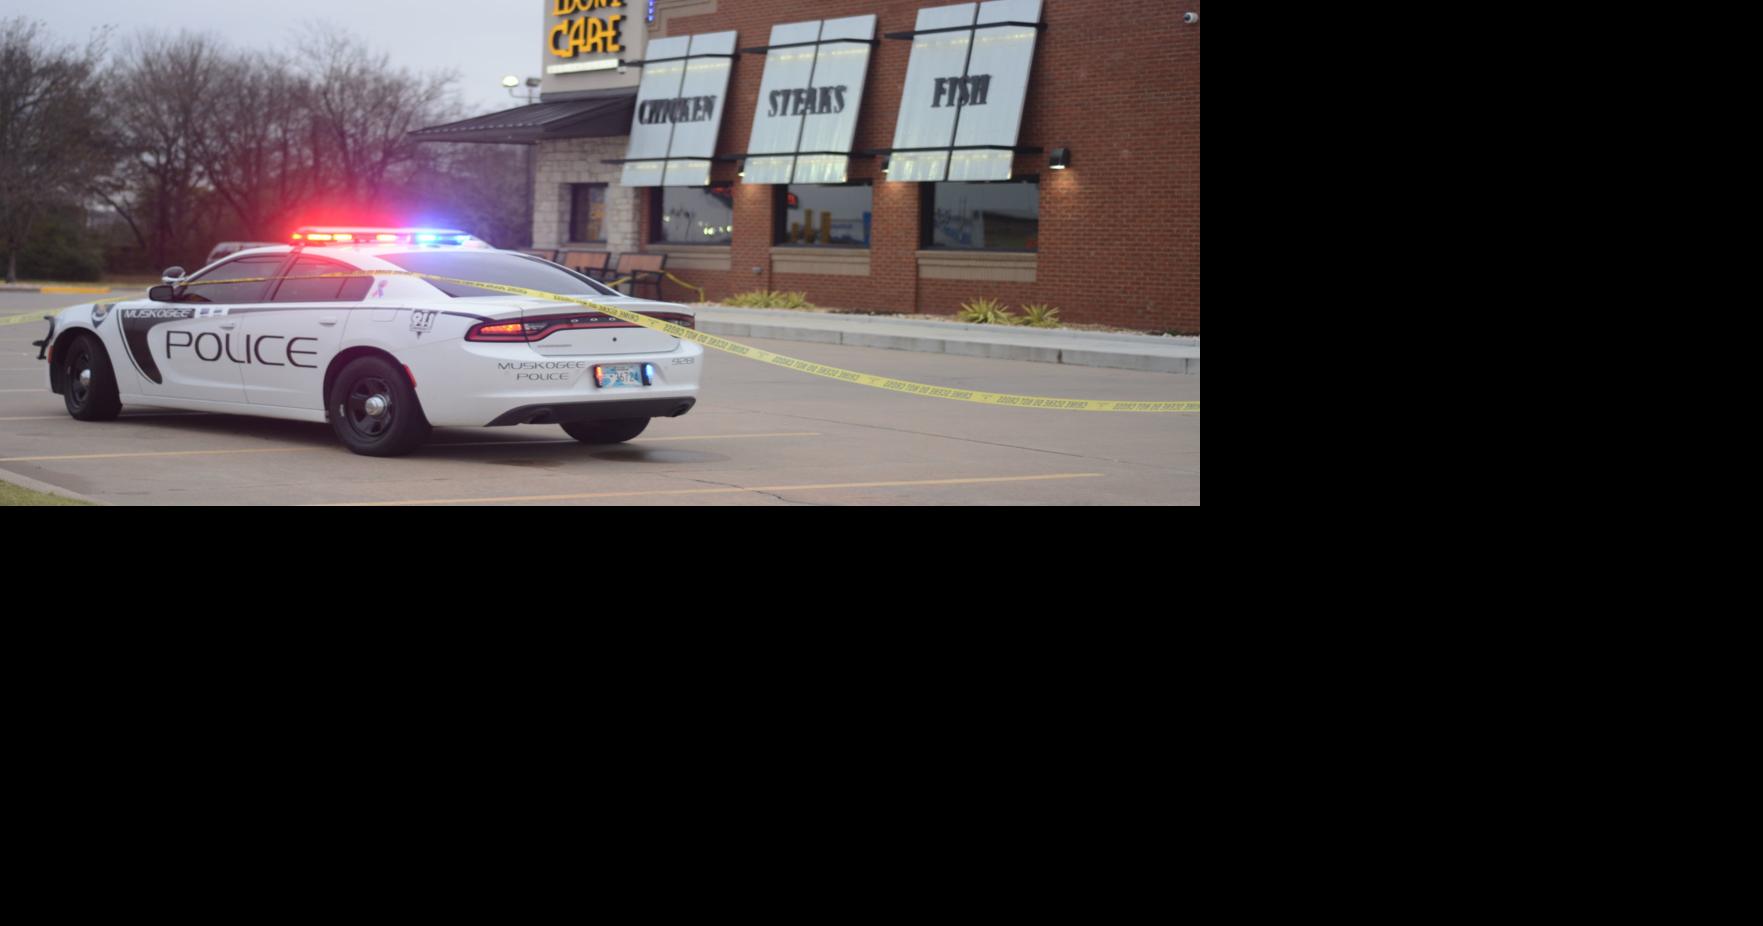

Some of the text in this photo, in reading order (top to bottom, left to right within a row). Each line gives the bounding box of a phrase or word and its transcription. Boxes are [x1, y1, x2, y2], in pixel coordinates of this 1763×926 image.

[548, 15, 622, 58] CARE
[768, 85, 847, 117] STEAKS
[931, 74, 992, 108] FISH
[638, 95, 717, 125] CHICKEN
[124, 309, 191, 319] MUSKOGEE
[166, 331, 318, 369] POLICE
[498, 360, 586, 370] MUSKOGEE
[516, 372, 569, 381] POLICE
